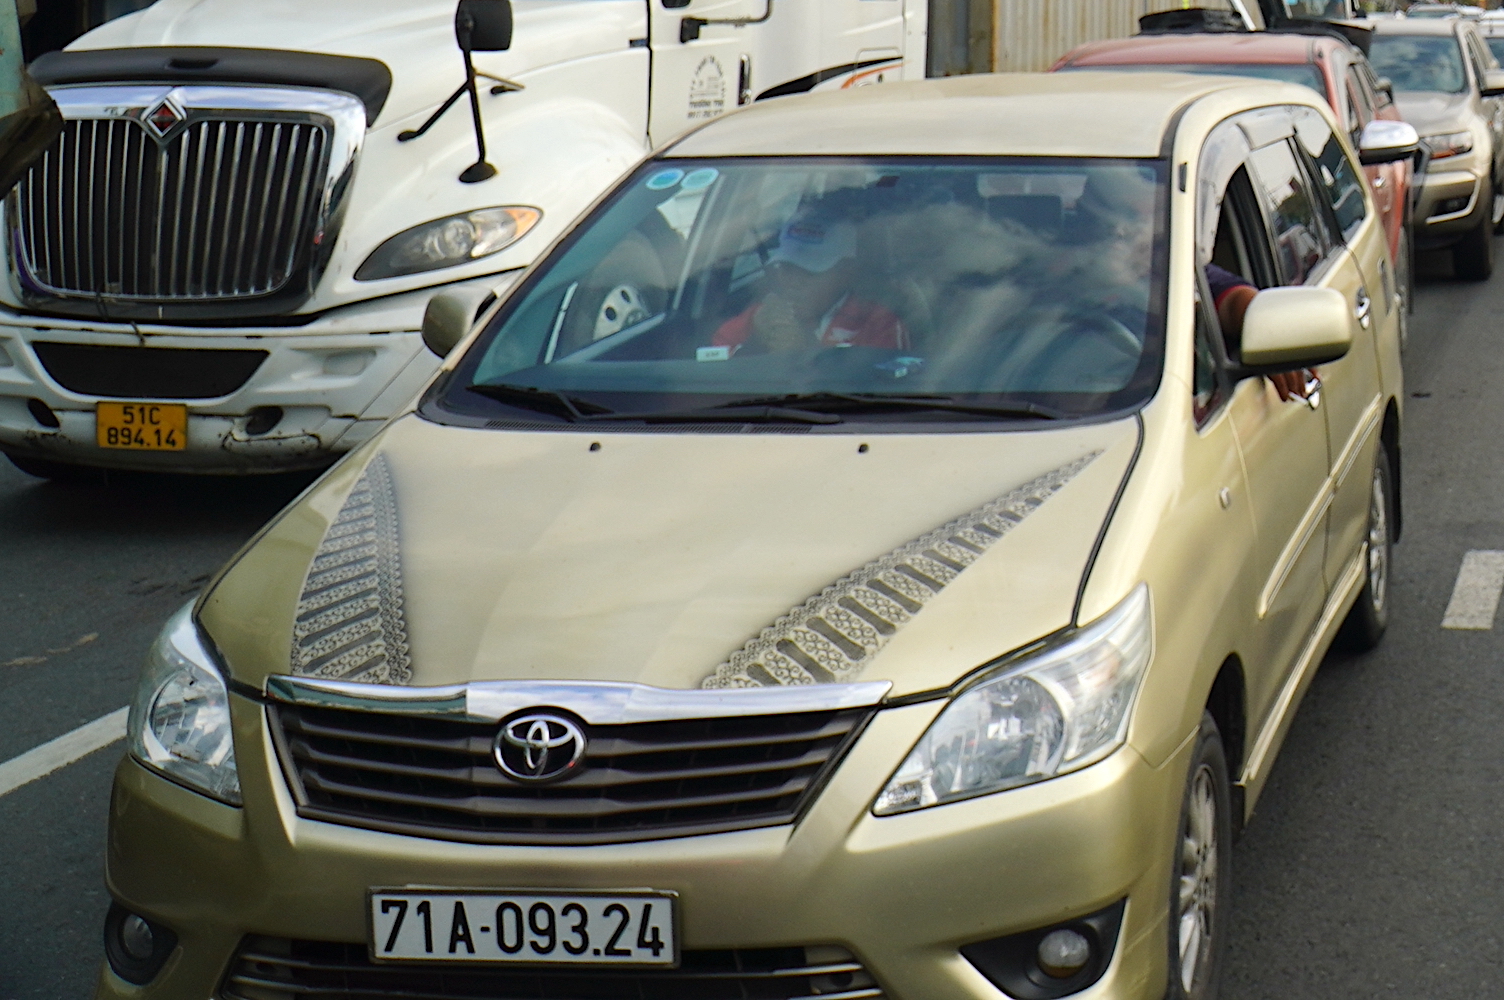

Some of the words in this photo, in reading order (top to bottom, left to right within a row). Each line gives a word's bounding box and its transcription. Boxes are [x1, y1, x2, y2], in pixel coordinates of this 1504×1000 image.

[122, 406, 161, 425] 51C
[106, 427, 177, 447] 894.14
[381, 899, 665, 957] 71A-093.24
